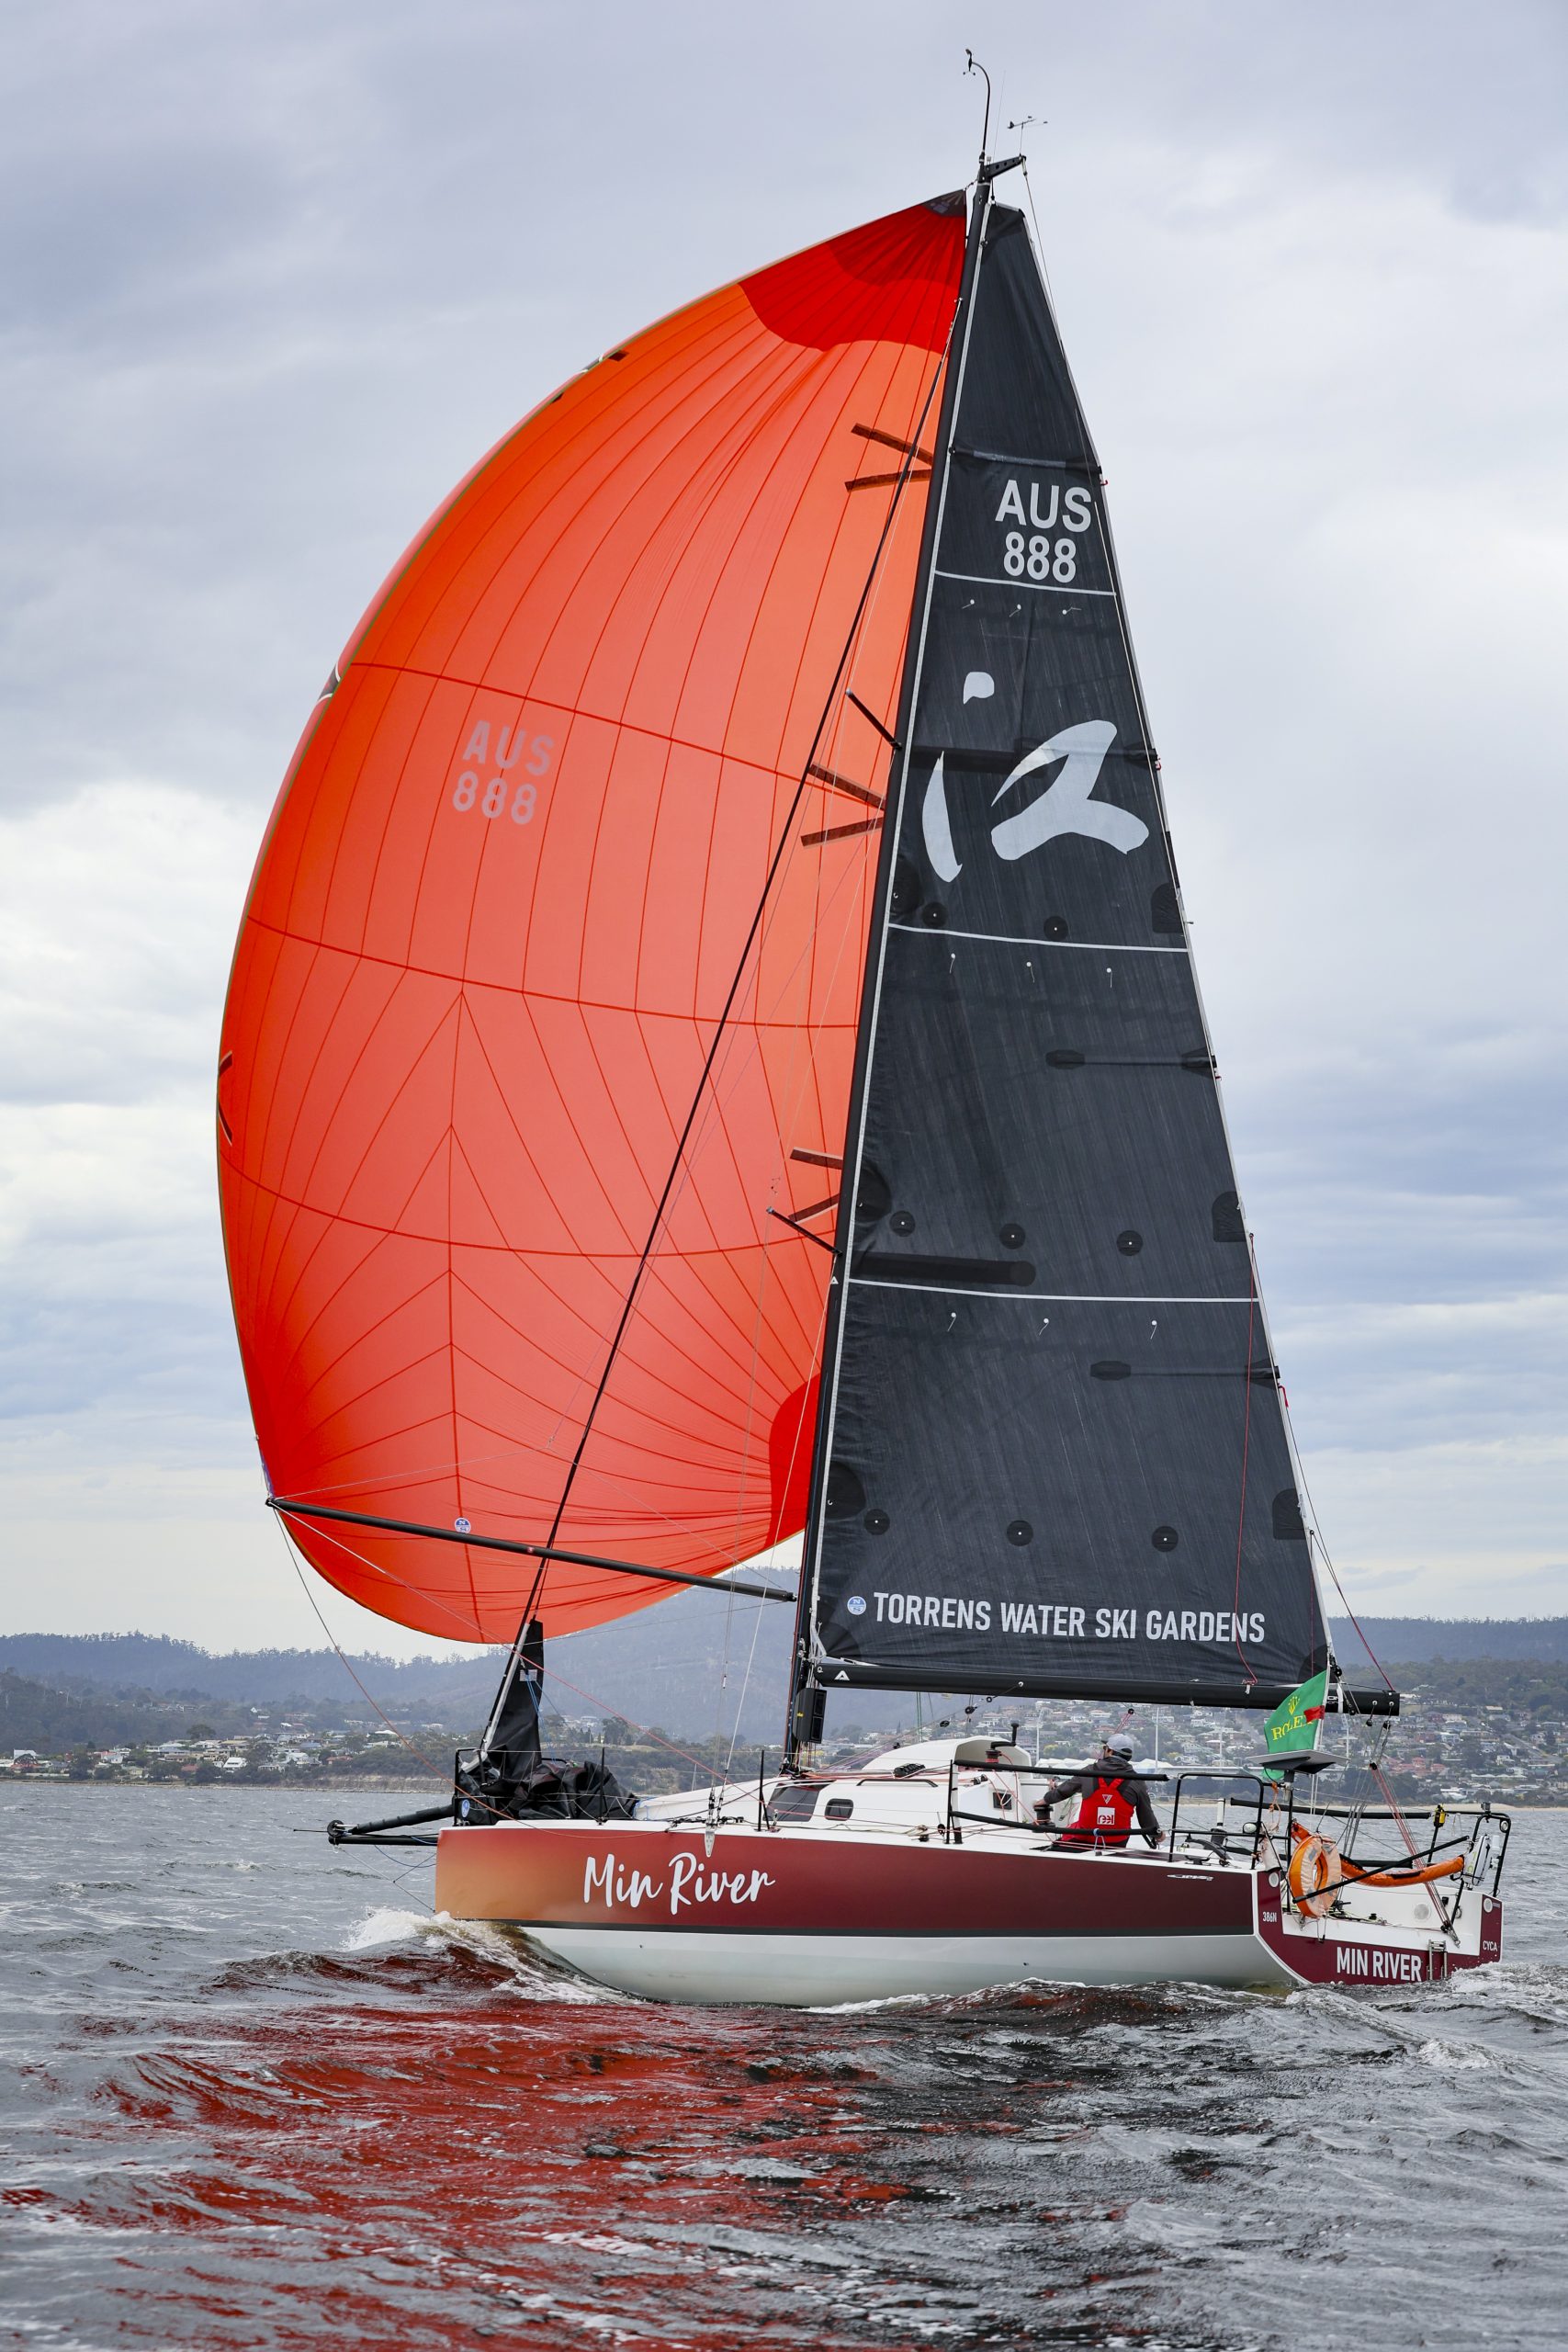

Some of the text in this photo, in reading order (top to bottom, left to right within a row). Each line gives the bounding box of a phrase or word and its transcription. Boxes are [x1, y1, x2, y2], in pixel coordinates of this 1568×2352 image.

[995, 480, 1091, 533] AUS
[1003, 531, 1077, 583] 888
[462, 719, 555, 776] AUS
[452, 770, 537, 825] 888
[874, 1591, 1266, 1643] TORRENS WATER SKI GARDENS
[1271, 1714, 1315, 1741] ROLE
[583, 1851, 776, 1915] Min River
[1337, 1946, 1423, 1983] MIN RIVER
[1483, 1939, 1498, 1952] CYCA
